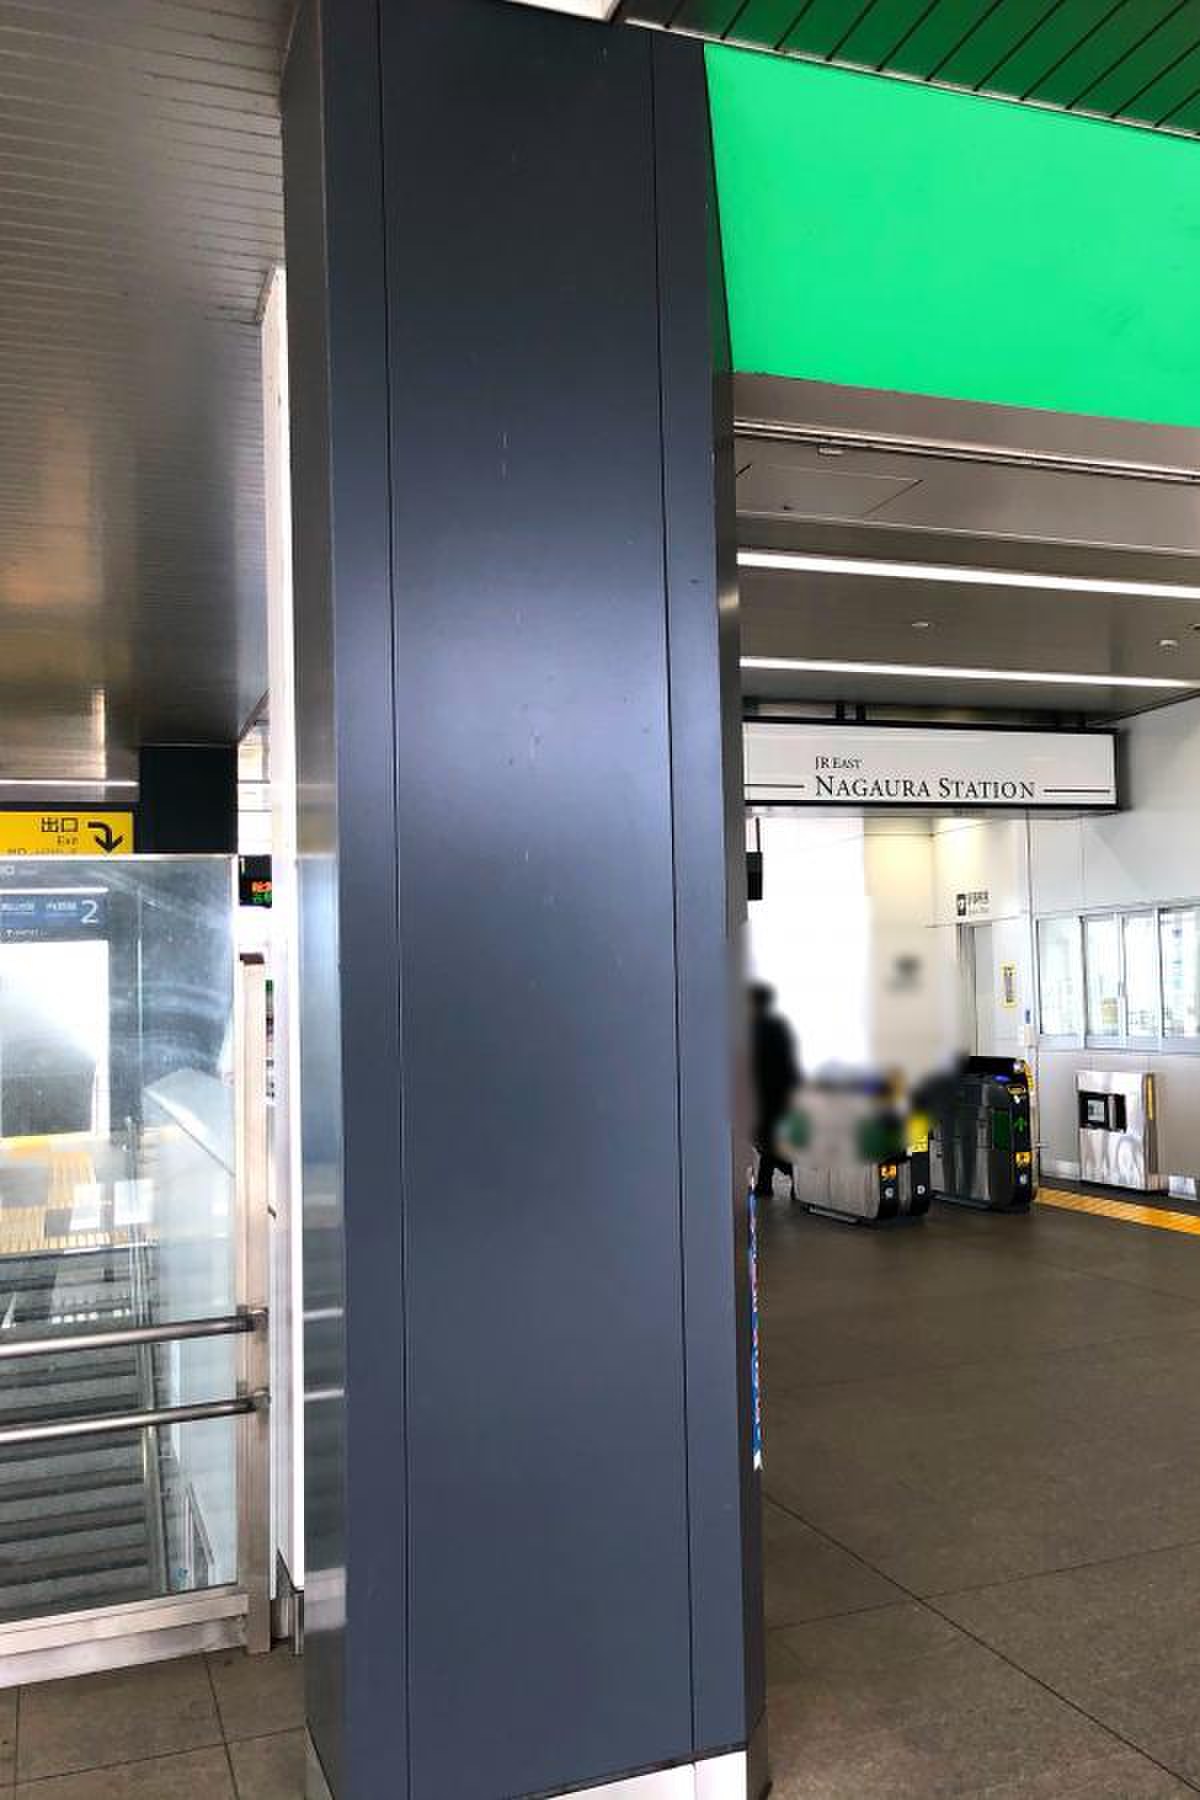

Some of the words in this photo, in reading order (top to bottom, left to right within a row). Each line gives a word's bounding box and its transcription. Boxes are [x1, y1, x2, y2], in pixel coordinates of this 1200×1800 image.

[815, 756, 830, 770] JR
[815, 775, 931, 797] NAGAURA
[938, 778, 1036, 799] STATION
[41, 816, 79, 833] 出口
[81, 900, 98, 924] 2
